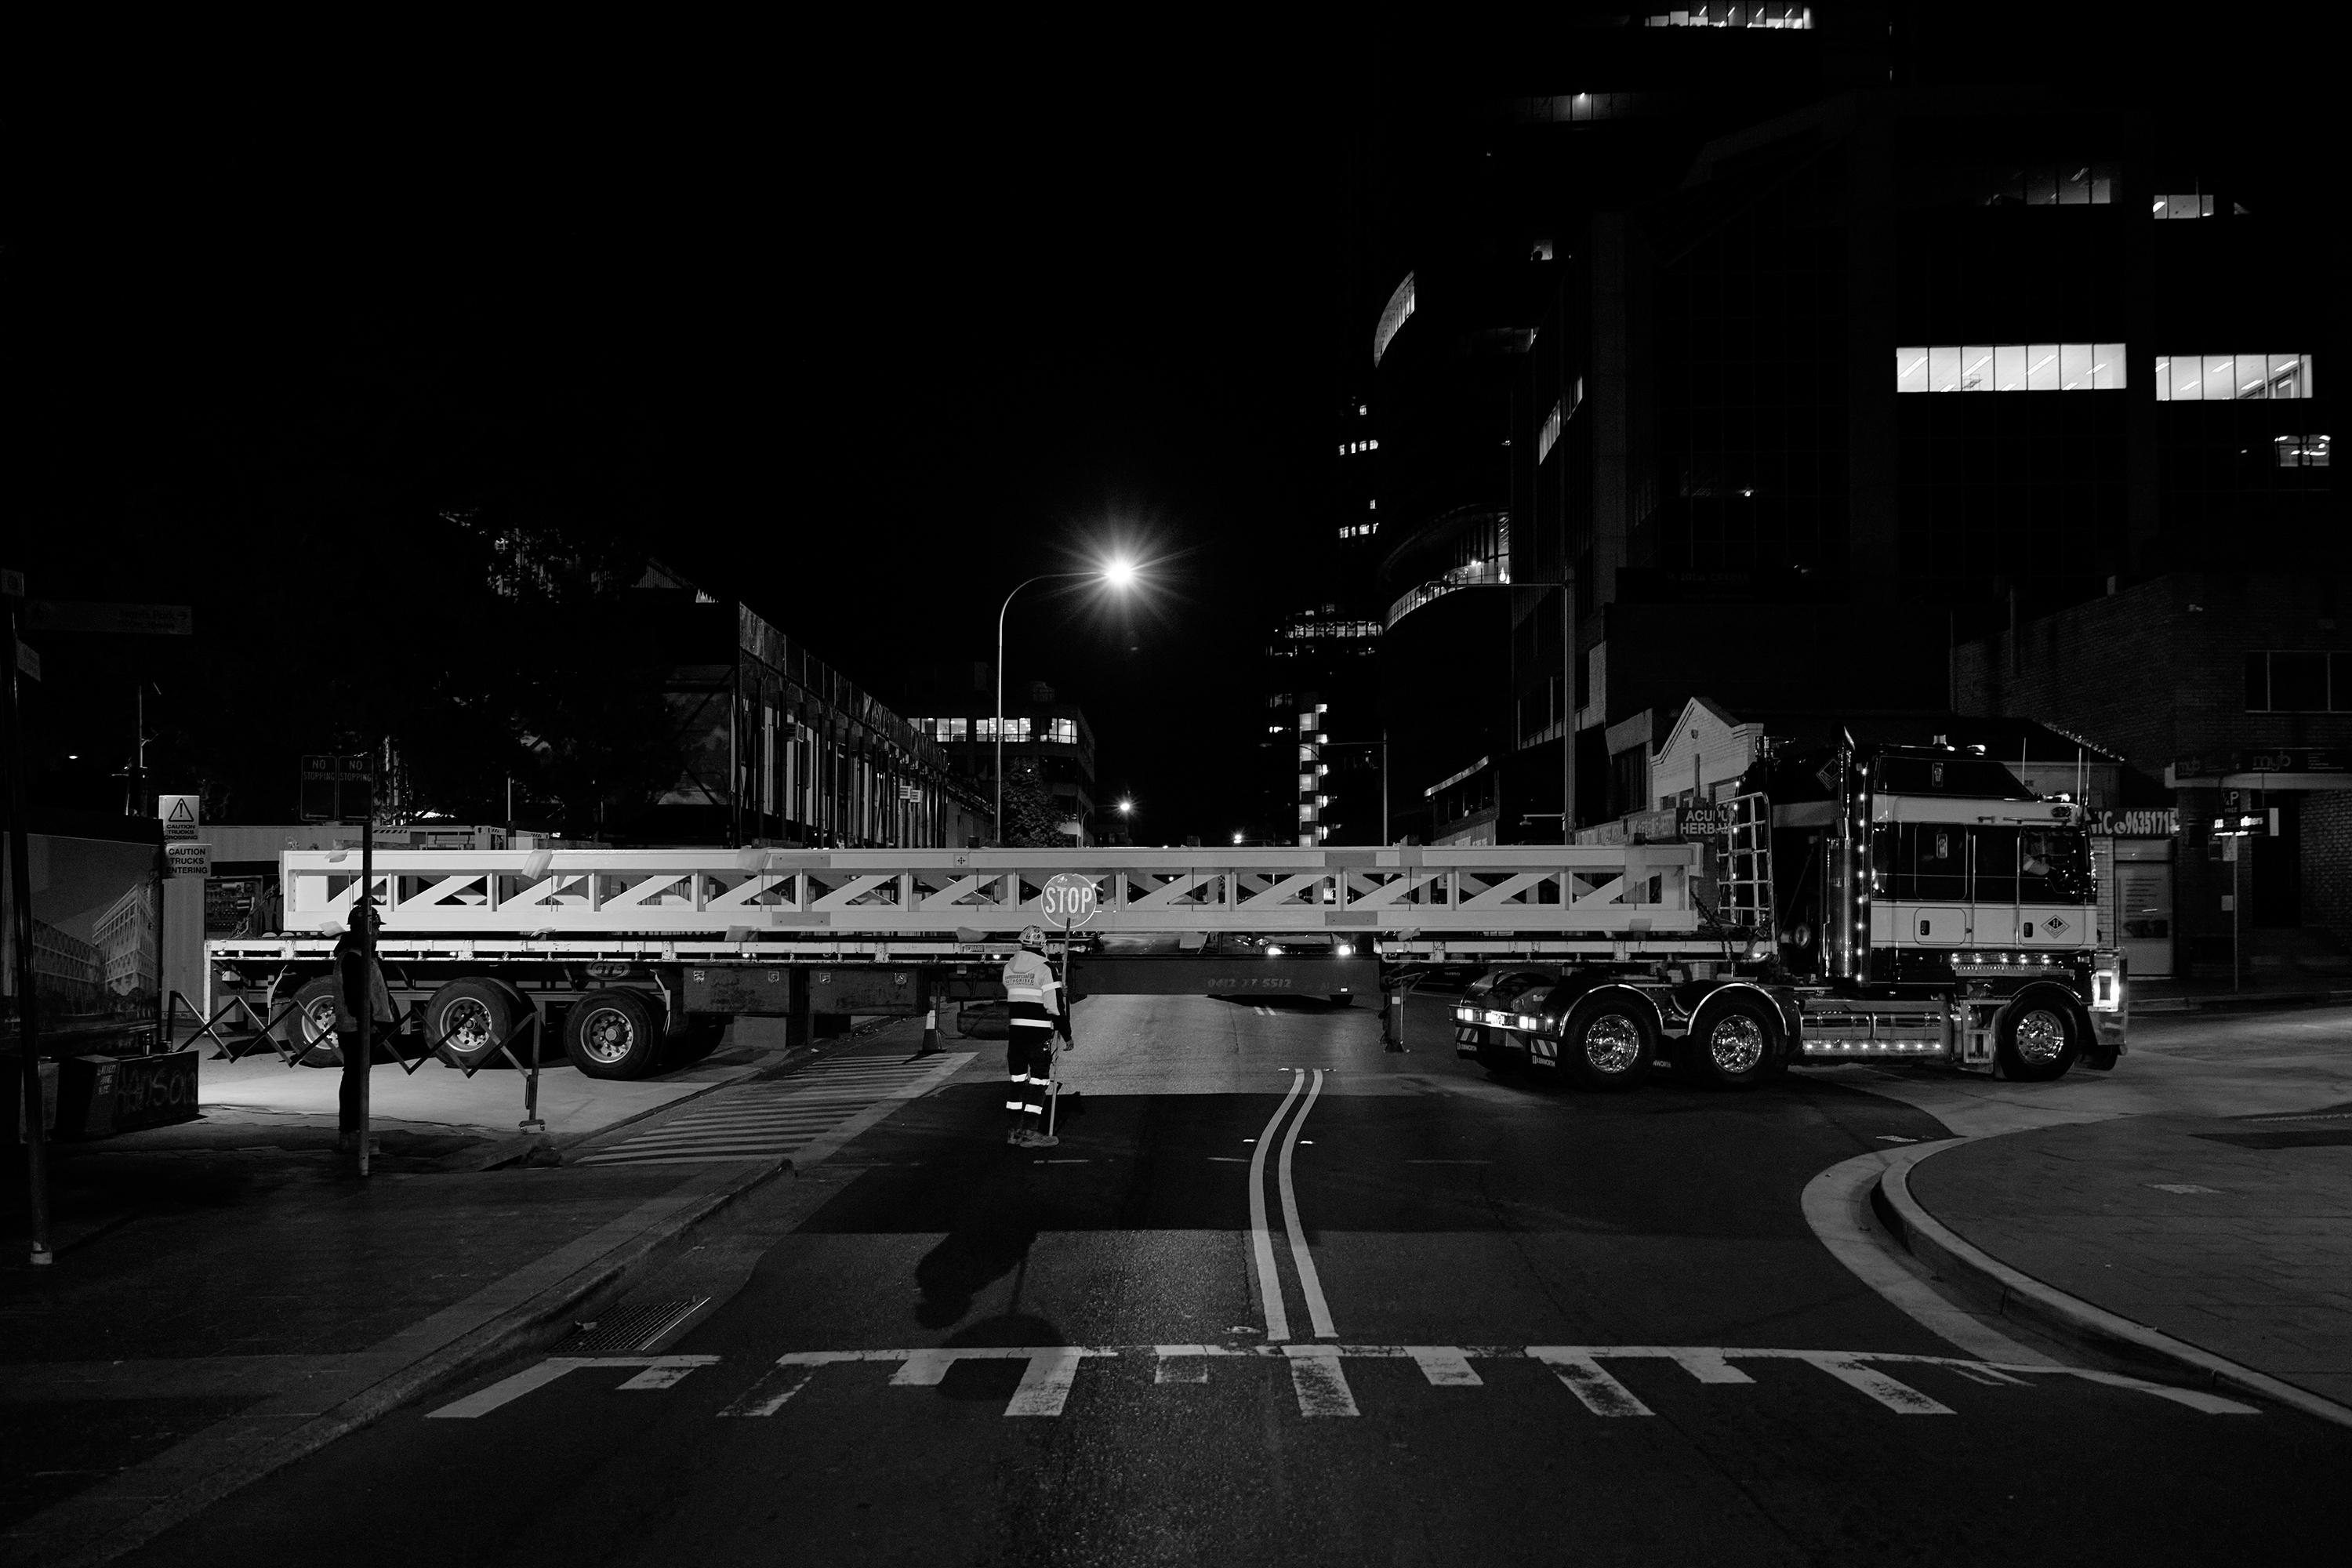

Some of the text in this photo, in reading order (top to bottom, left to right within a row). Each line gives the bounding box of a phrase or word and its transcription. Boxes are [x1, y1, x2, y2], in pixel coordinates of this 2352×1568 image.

[312, 759, 326, 770] NO
[349, 760, 363, 771] NO
[303, 771, 335, 781] STOPPING
[339, 772, 372, 782] STOPPING
[1045, 887, 1092, 913] STOP
